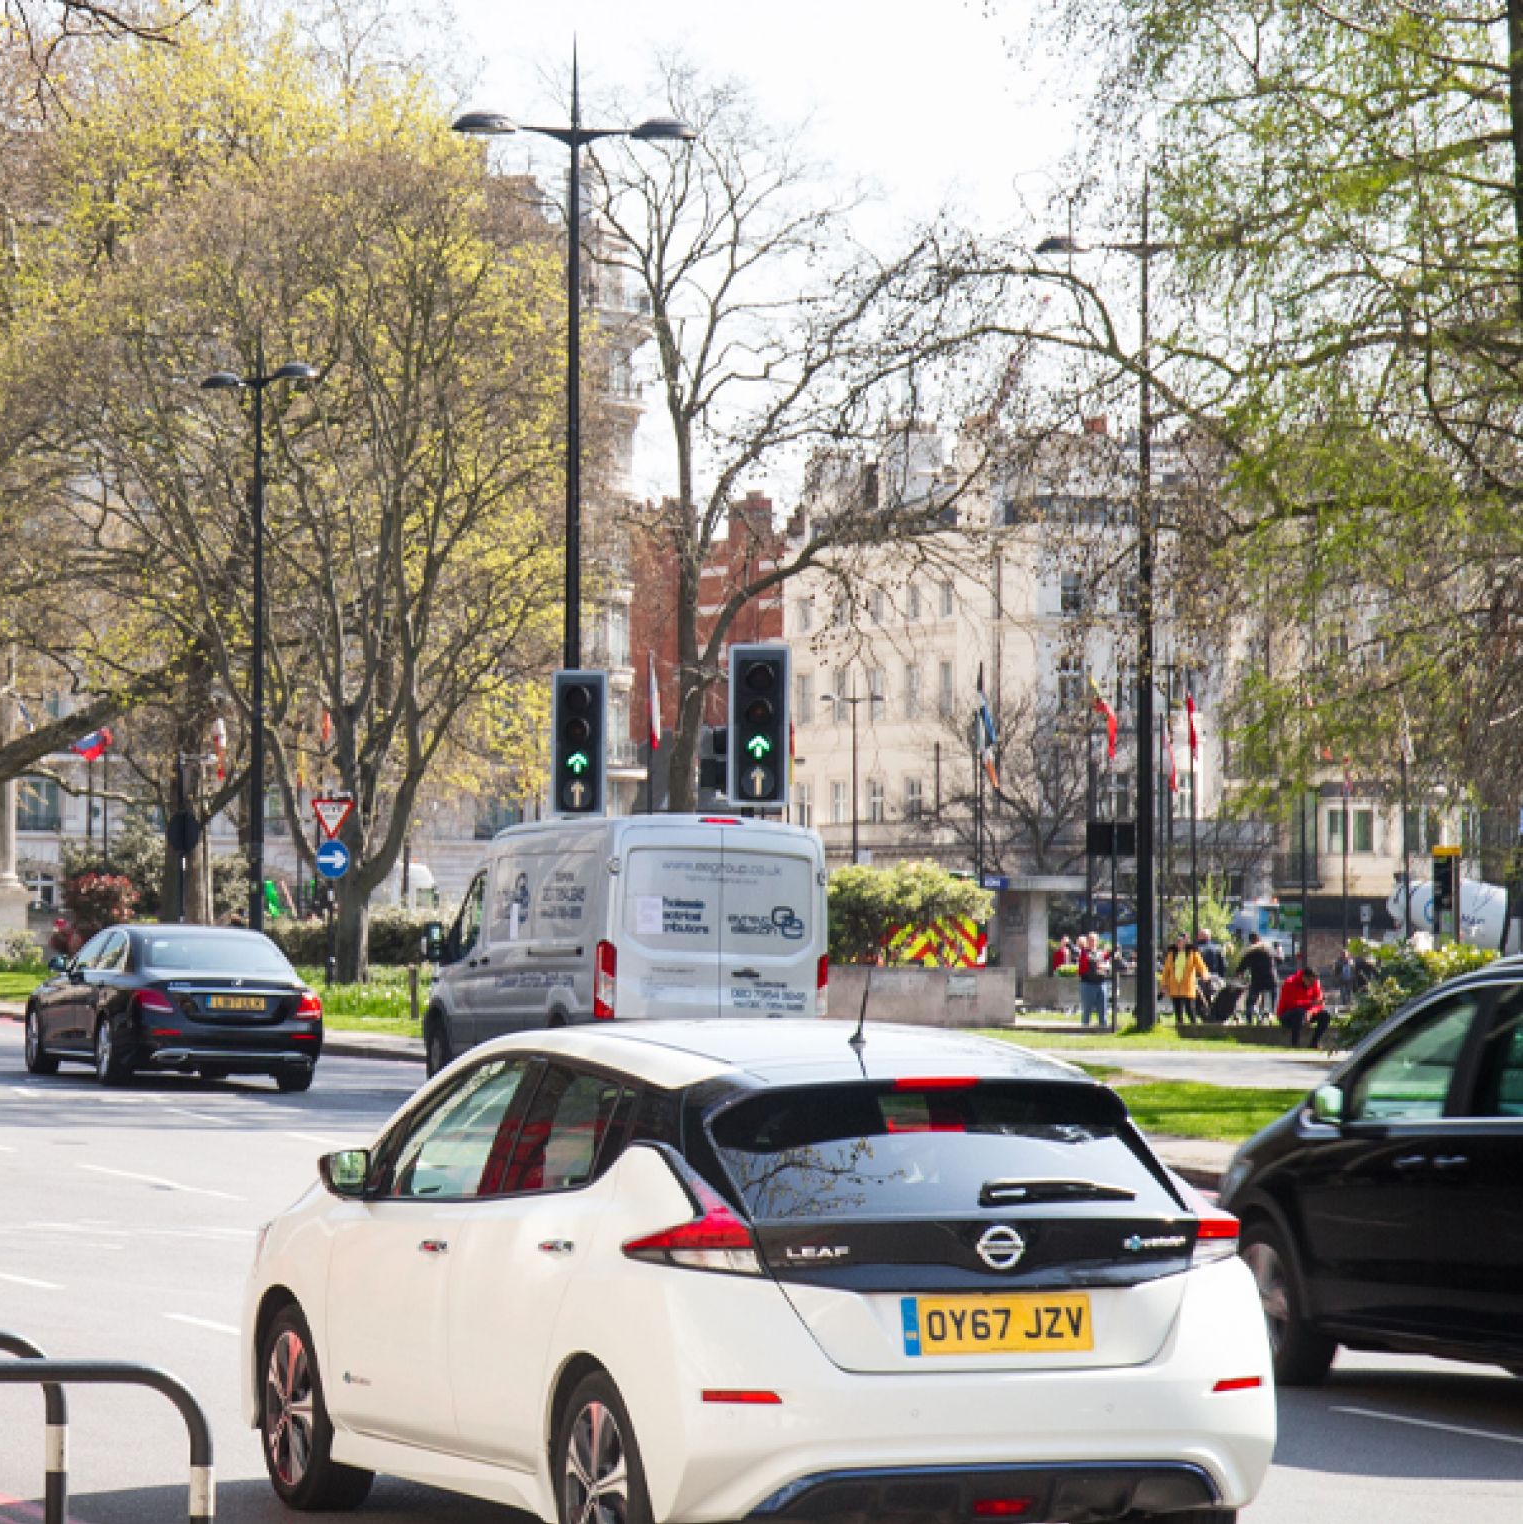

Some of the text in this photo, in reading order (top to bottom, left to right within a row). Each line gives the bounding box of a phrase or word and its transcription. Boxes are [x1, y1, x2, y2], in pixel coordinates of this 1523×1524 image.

[786, 1245, 850, 1260] LEAF
[927, 1306, 1083, 1341] OY67 JZV
